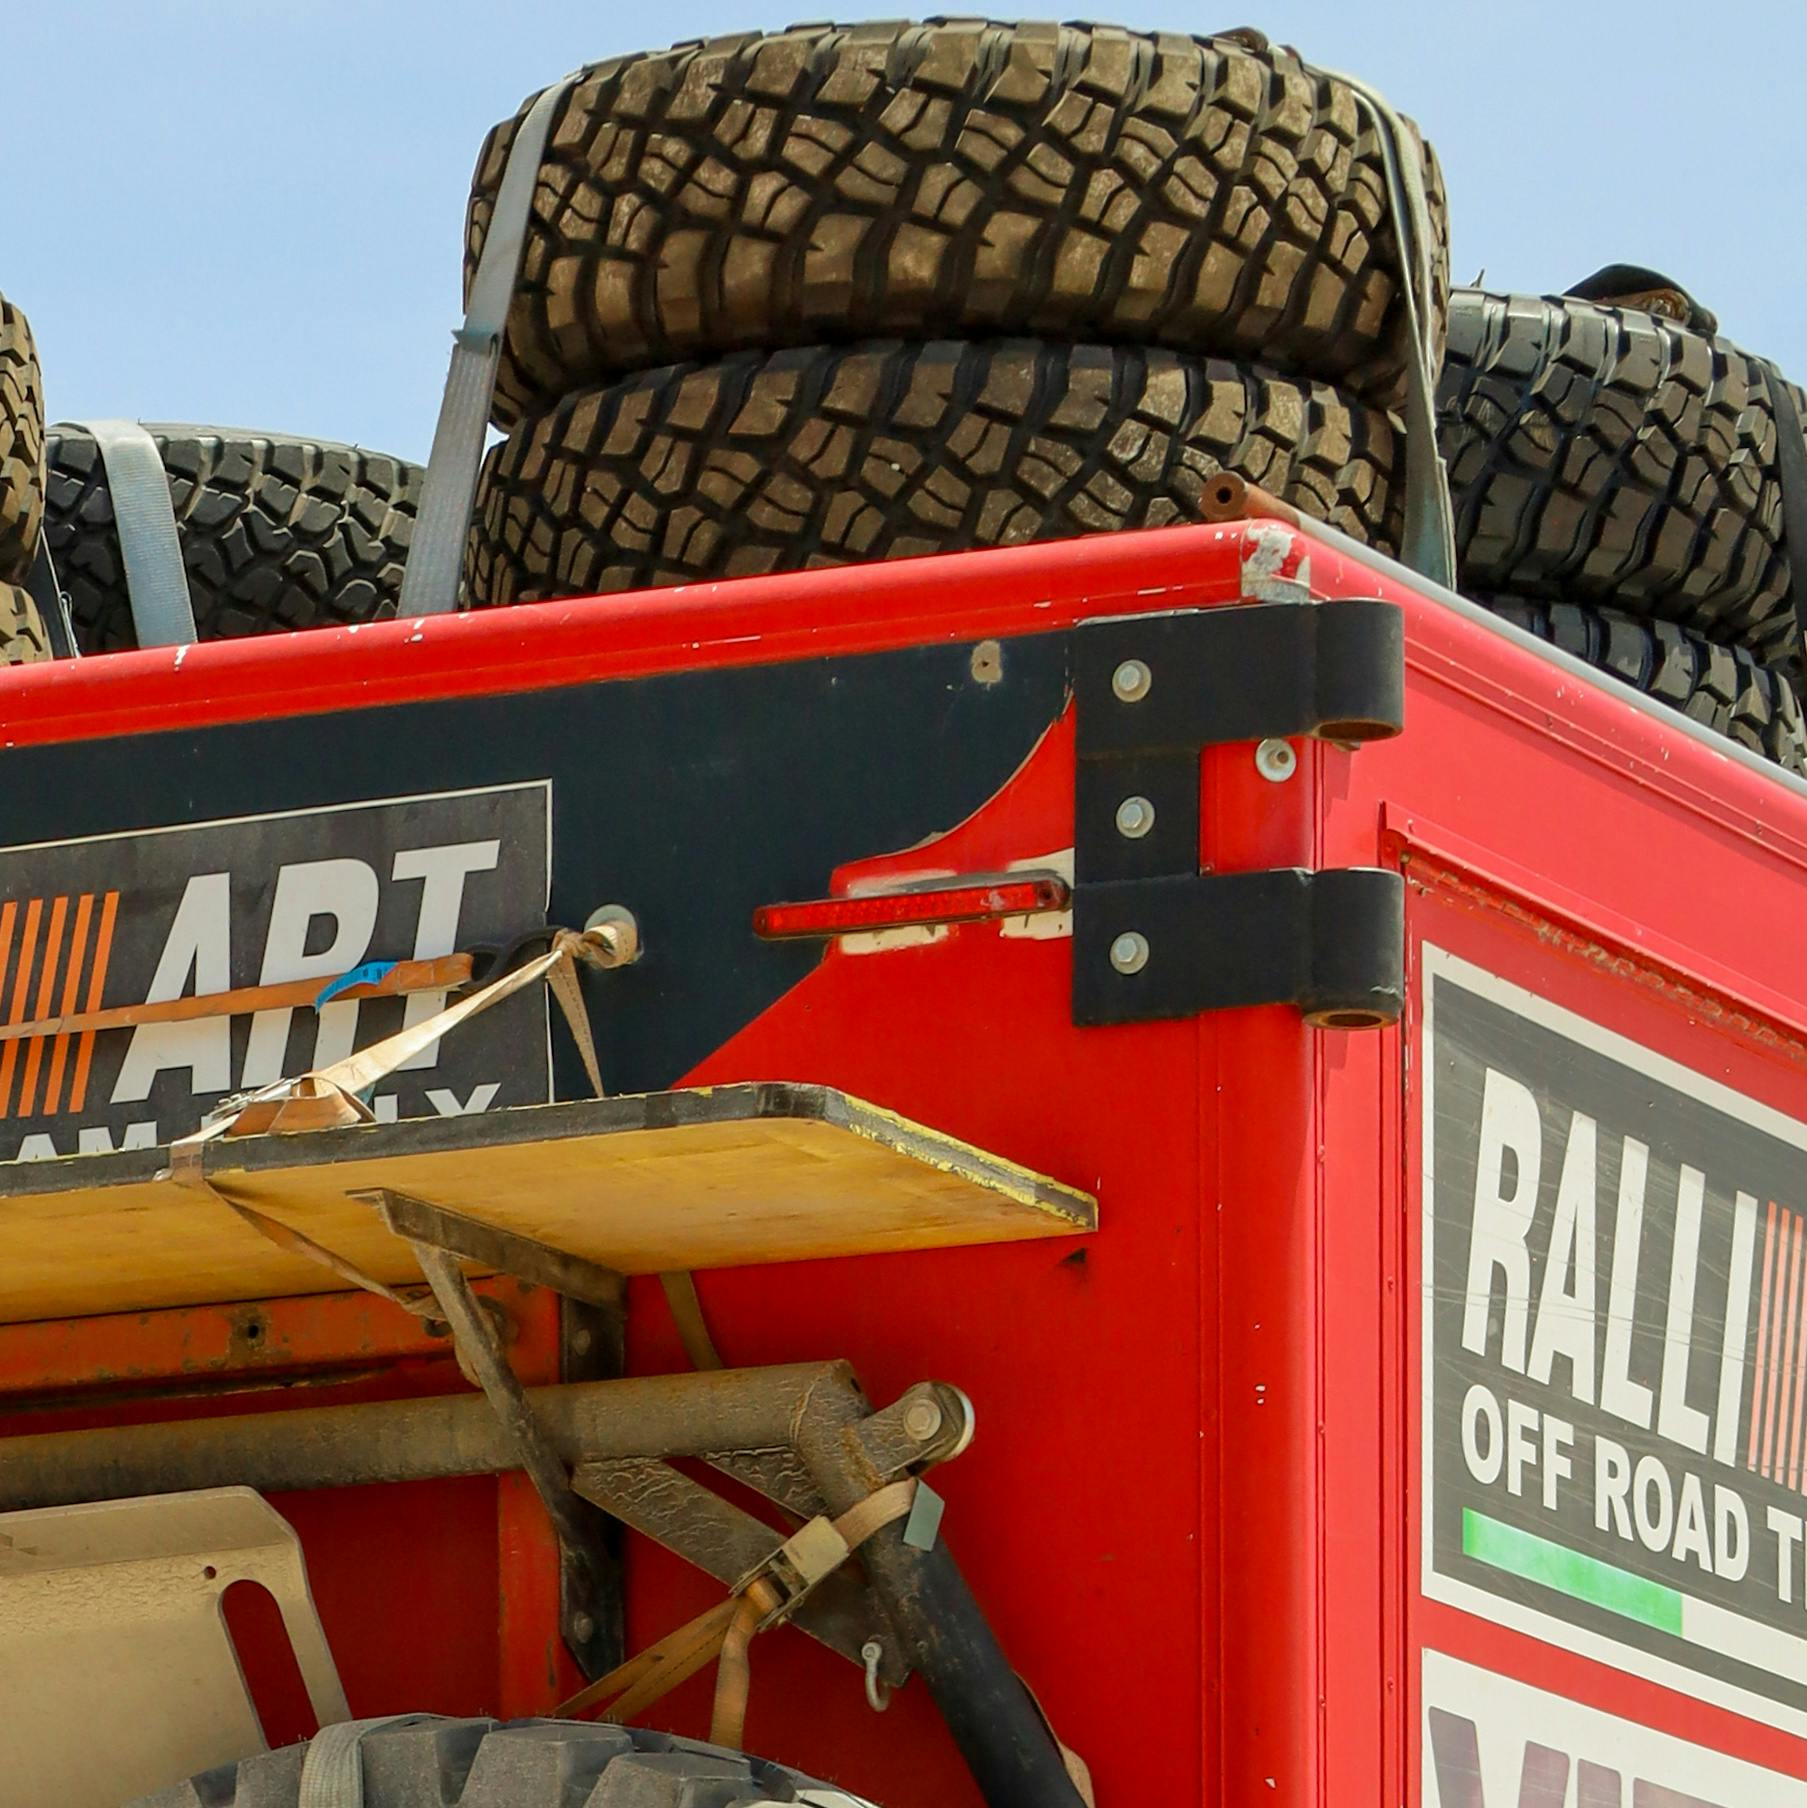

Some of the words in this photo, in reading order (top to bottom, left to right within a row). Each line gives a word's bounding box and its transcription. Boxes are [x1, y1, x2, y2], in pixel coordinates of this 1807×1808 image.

[111, 840, 501, 1104] ART
[1461, 1067, 1758, 1468] RALLI
[1461, 1384, 1574, 1511] OFF
[1595, 1435, 1750, 1582] ROAD
